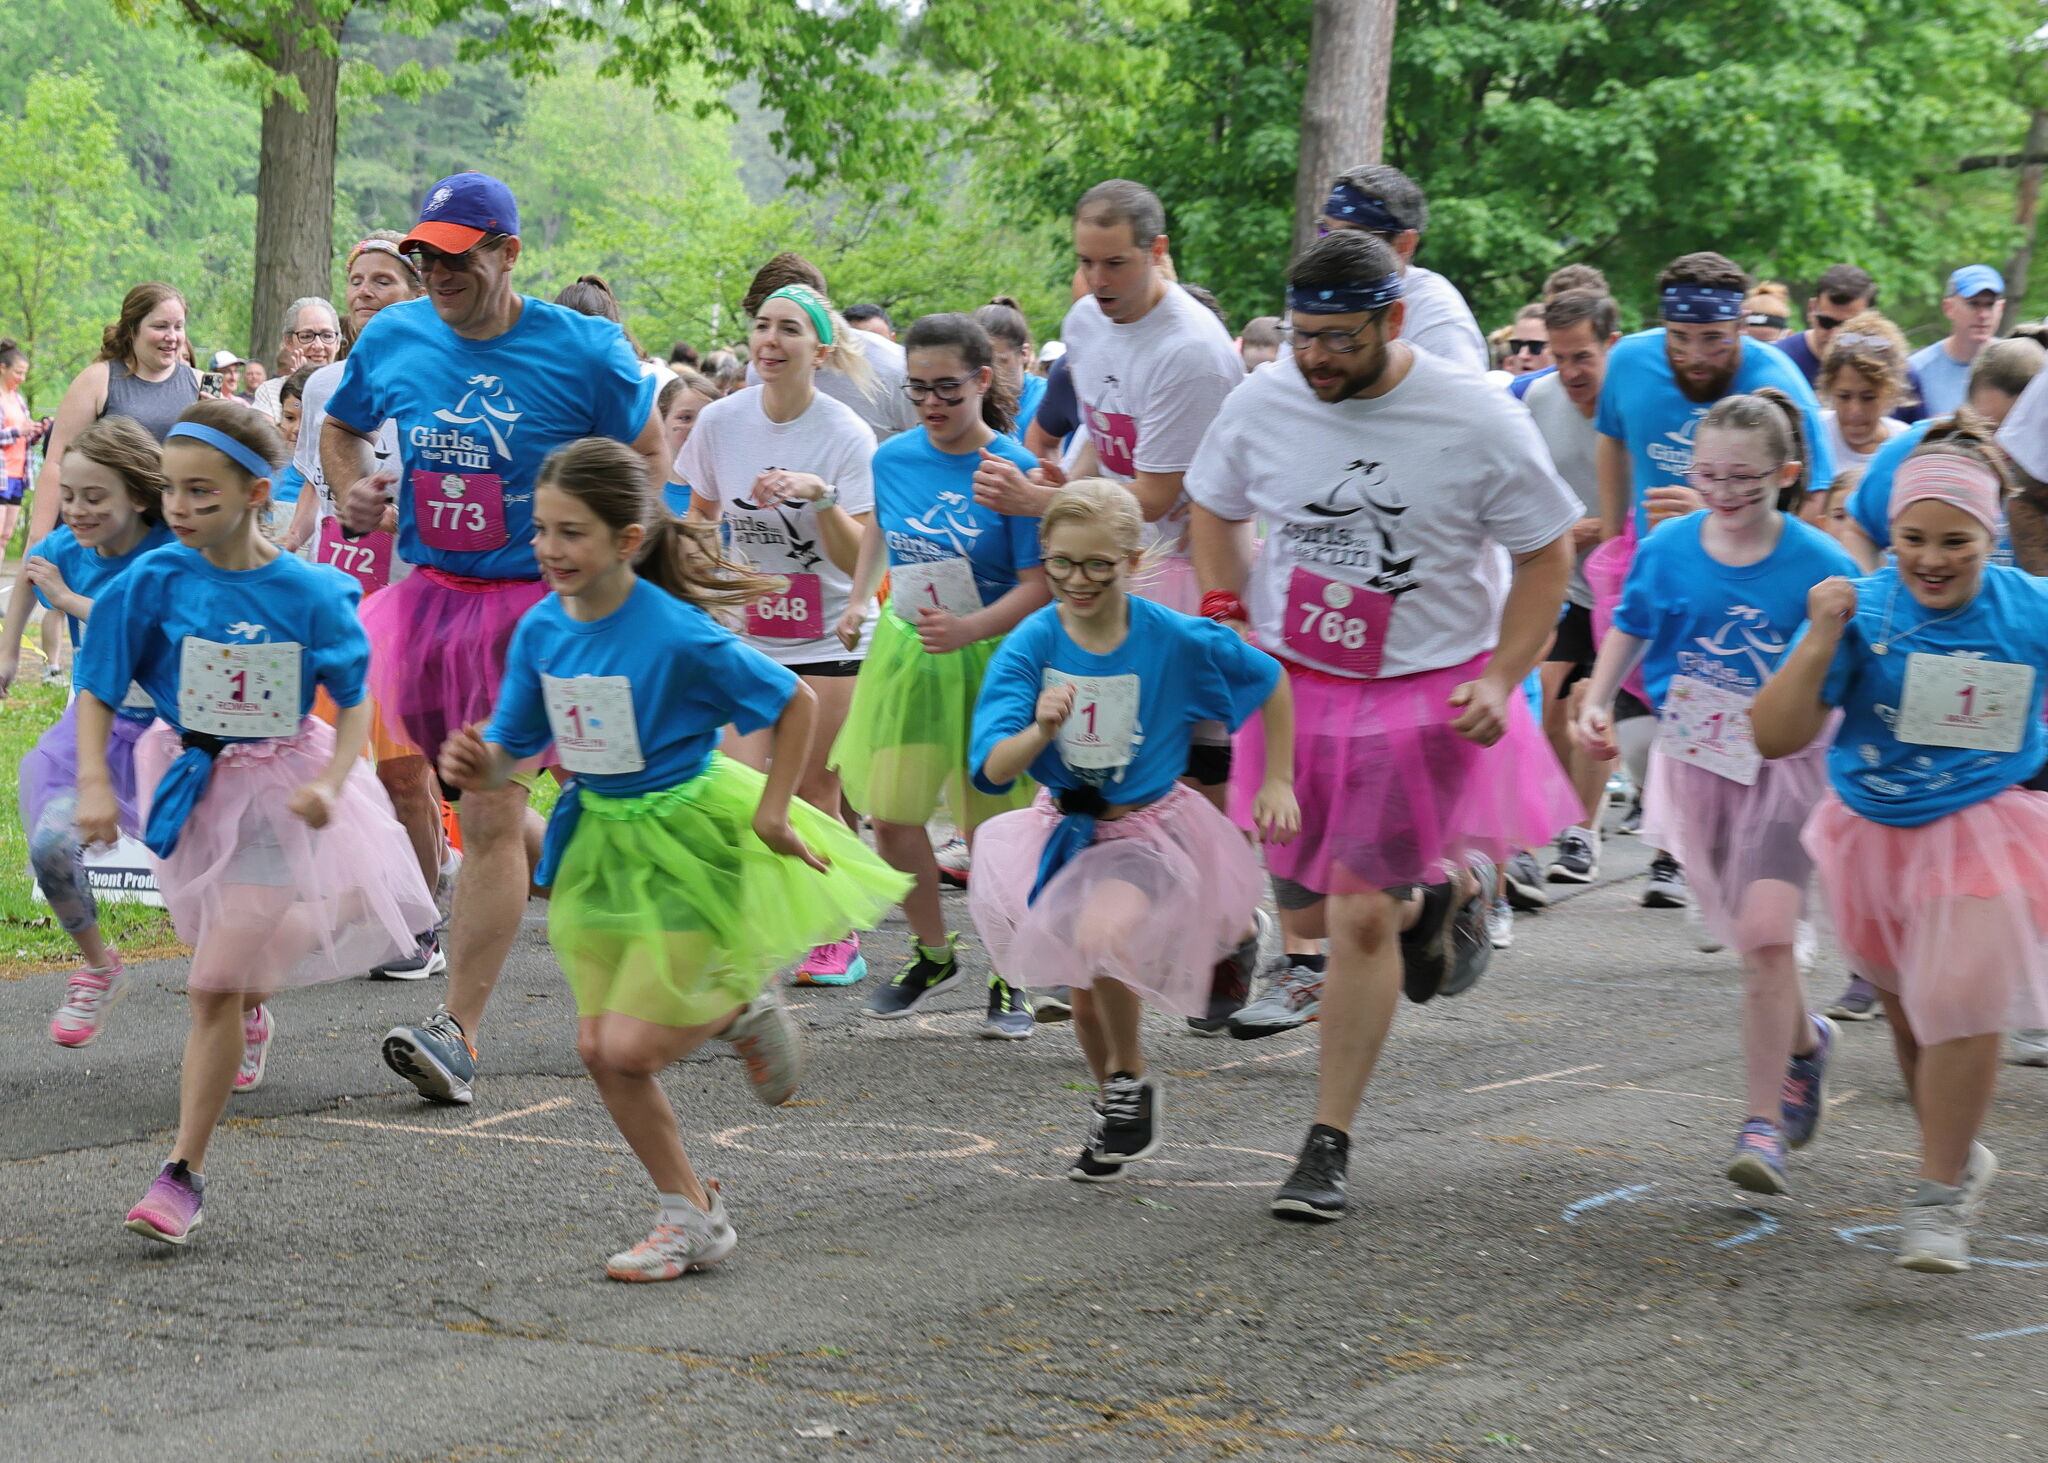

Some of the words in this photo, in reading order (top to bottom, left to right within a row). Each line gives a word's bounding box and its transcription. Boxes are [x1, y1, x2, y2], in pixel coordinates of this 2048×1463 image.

[410, 425, 475, 452] Girls
[421, 449, 443, 460] the
[440, 449, 492, 470] run
[427, 500, 487, 532] 773
[733, 515, 768, 533] irls
[744, 532, 787, 545] run
[329, 541, 376, 575] 772
[1310, 546, 1370, 568] run
[756, 596, 809, 622] 648
[1299, 602, 1368, 650] 768
[229, 670, 247, 703] 1
[1954, 684, 1977, 716] 1
[565, 704, 584, 738] 1
[1080, 702, 1097, 734] 1
[1706, 712, 1724, 740] 1
[88, 869, 123, 888] Event
